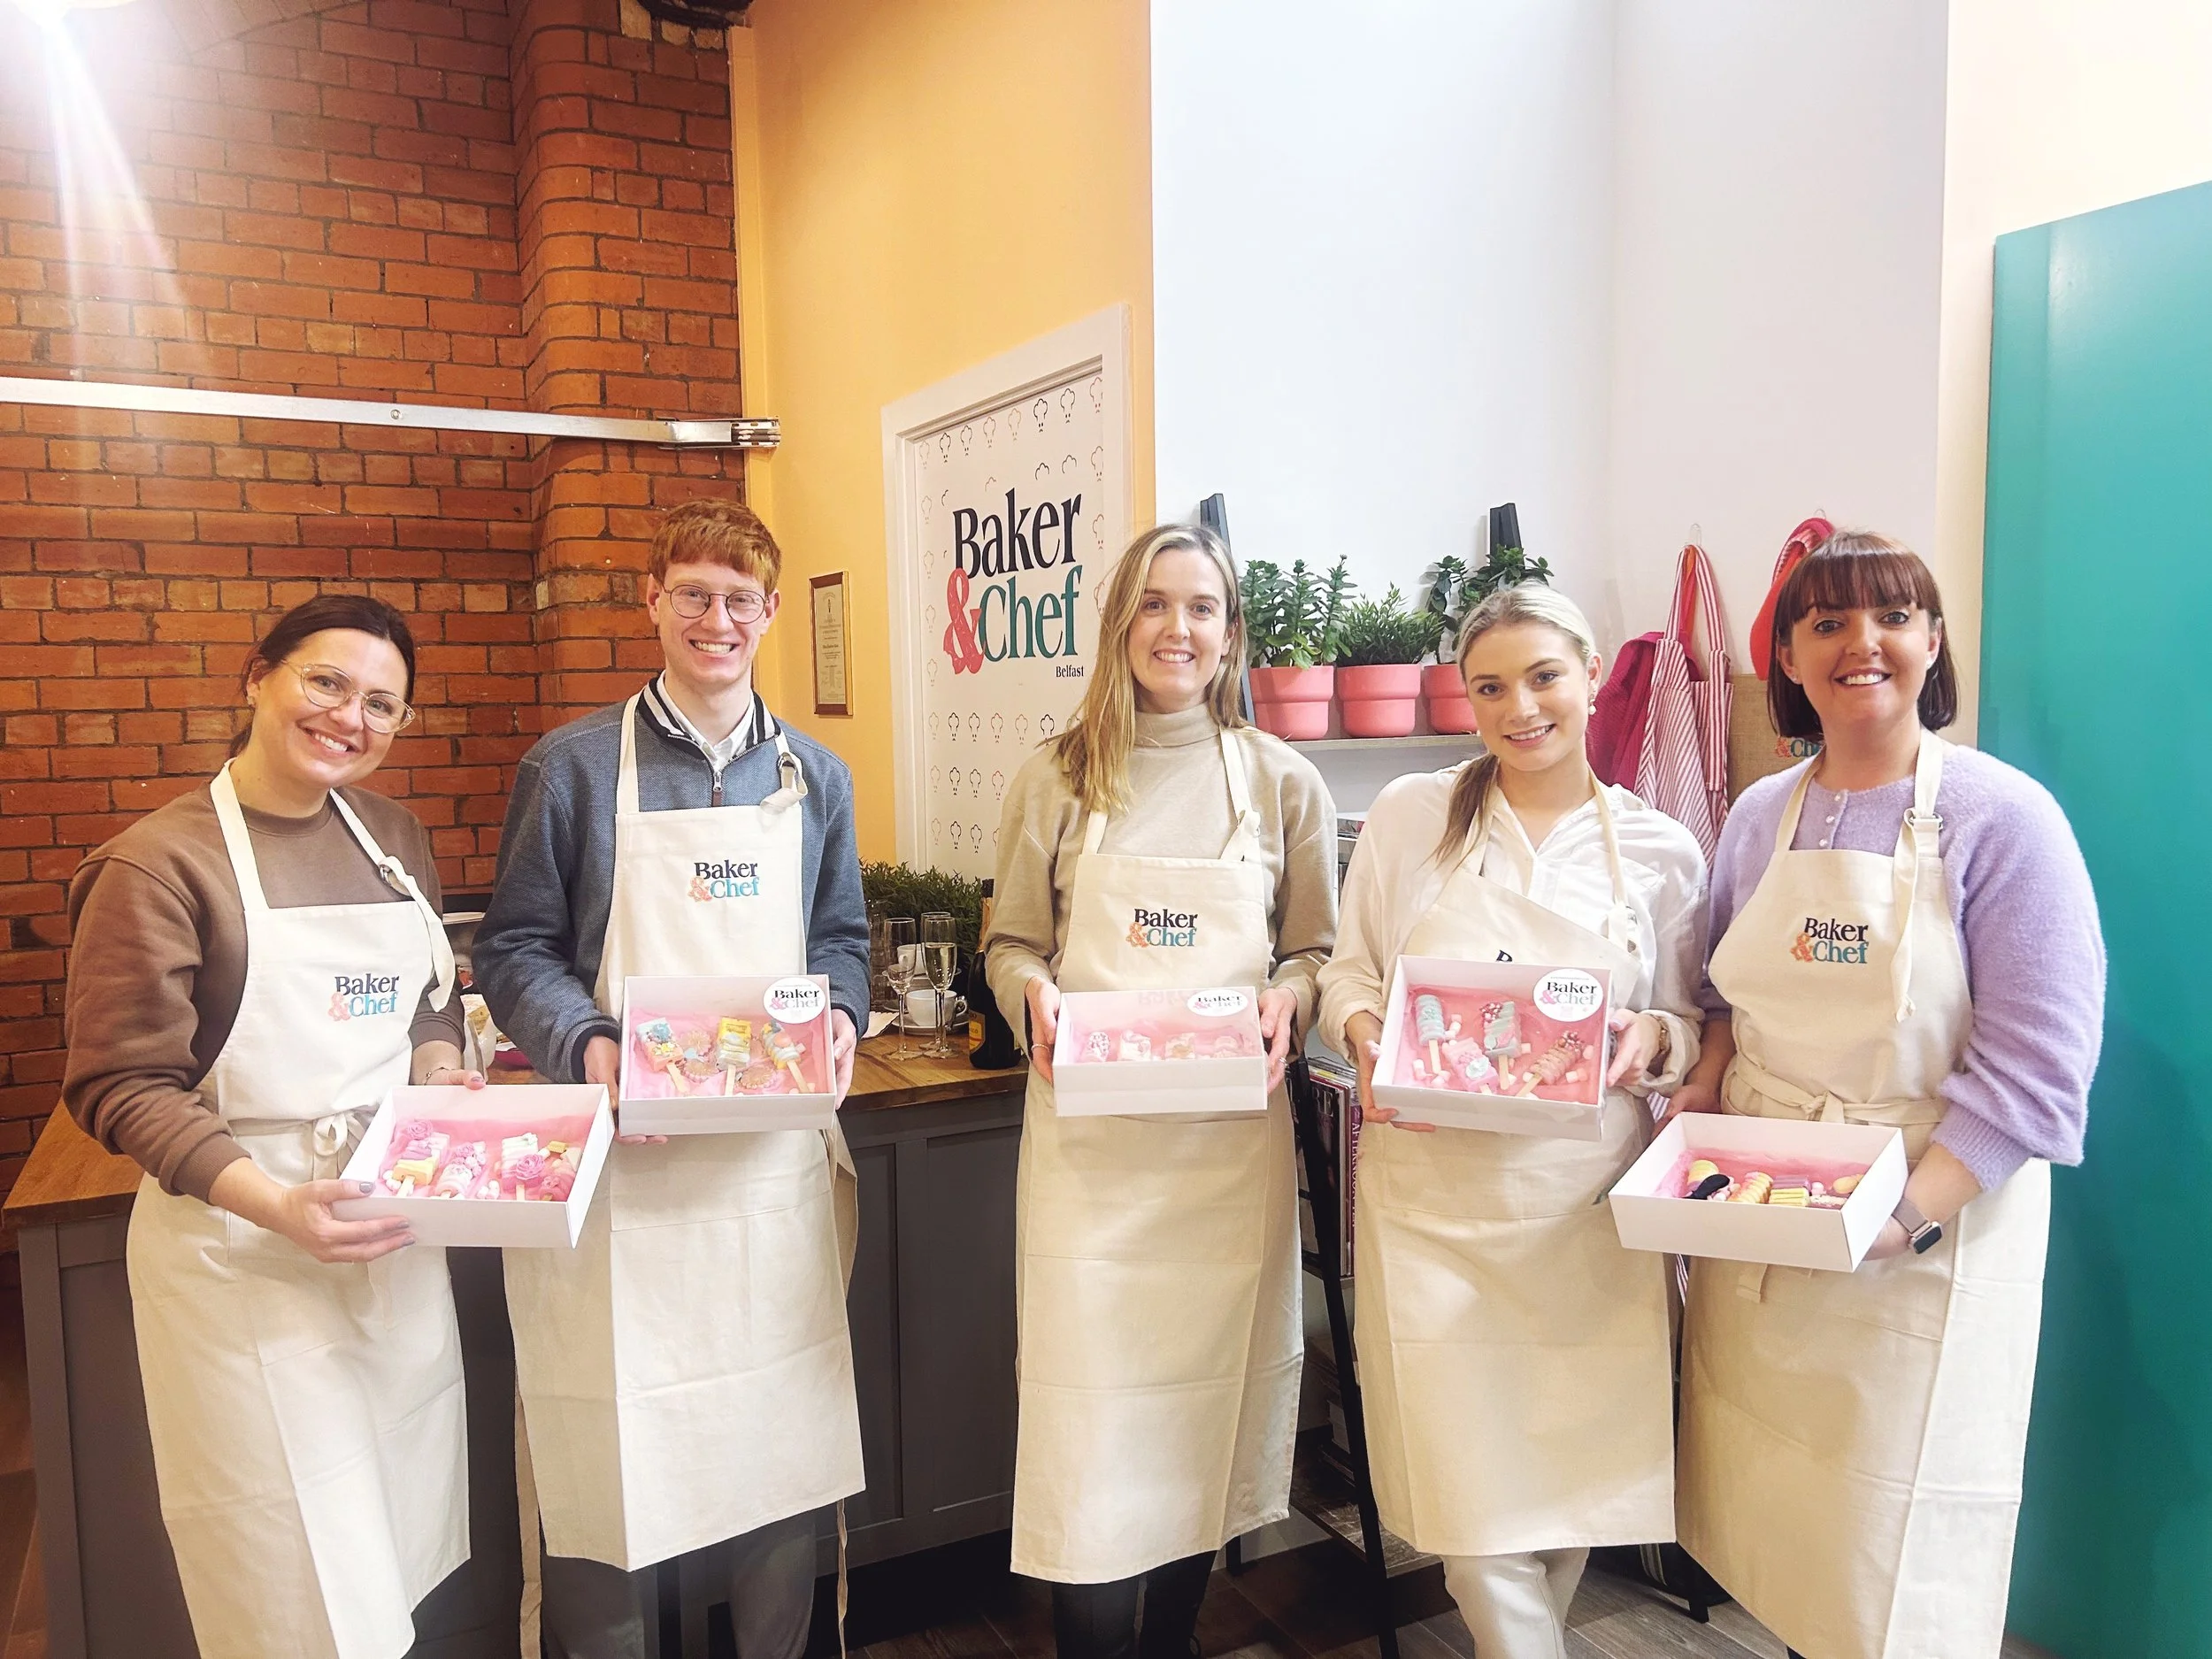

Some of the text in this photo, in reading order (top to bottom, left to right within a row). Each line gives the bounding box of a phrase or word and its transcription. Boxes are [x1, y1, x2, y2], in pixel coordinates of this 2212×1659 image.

[953, 488, 1082, 579] Baker
[1056, 664, 1084, 678] Belfast
[693, 859, 758, 879] Baker
[1134, 908, 1198, 928] Baker
[1804, 917, 1869, 941] Baker
[334, 973, 400, 995] Baker
[774, 988, 819, 999] Baker
[1547, 981, 1597, 995] Baker
